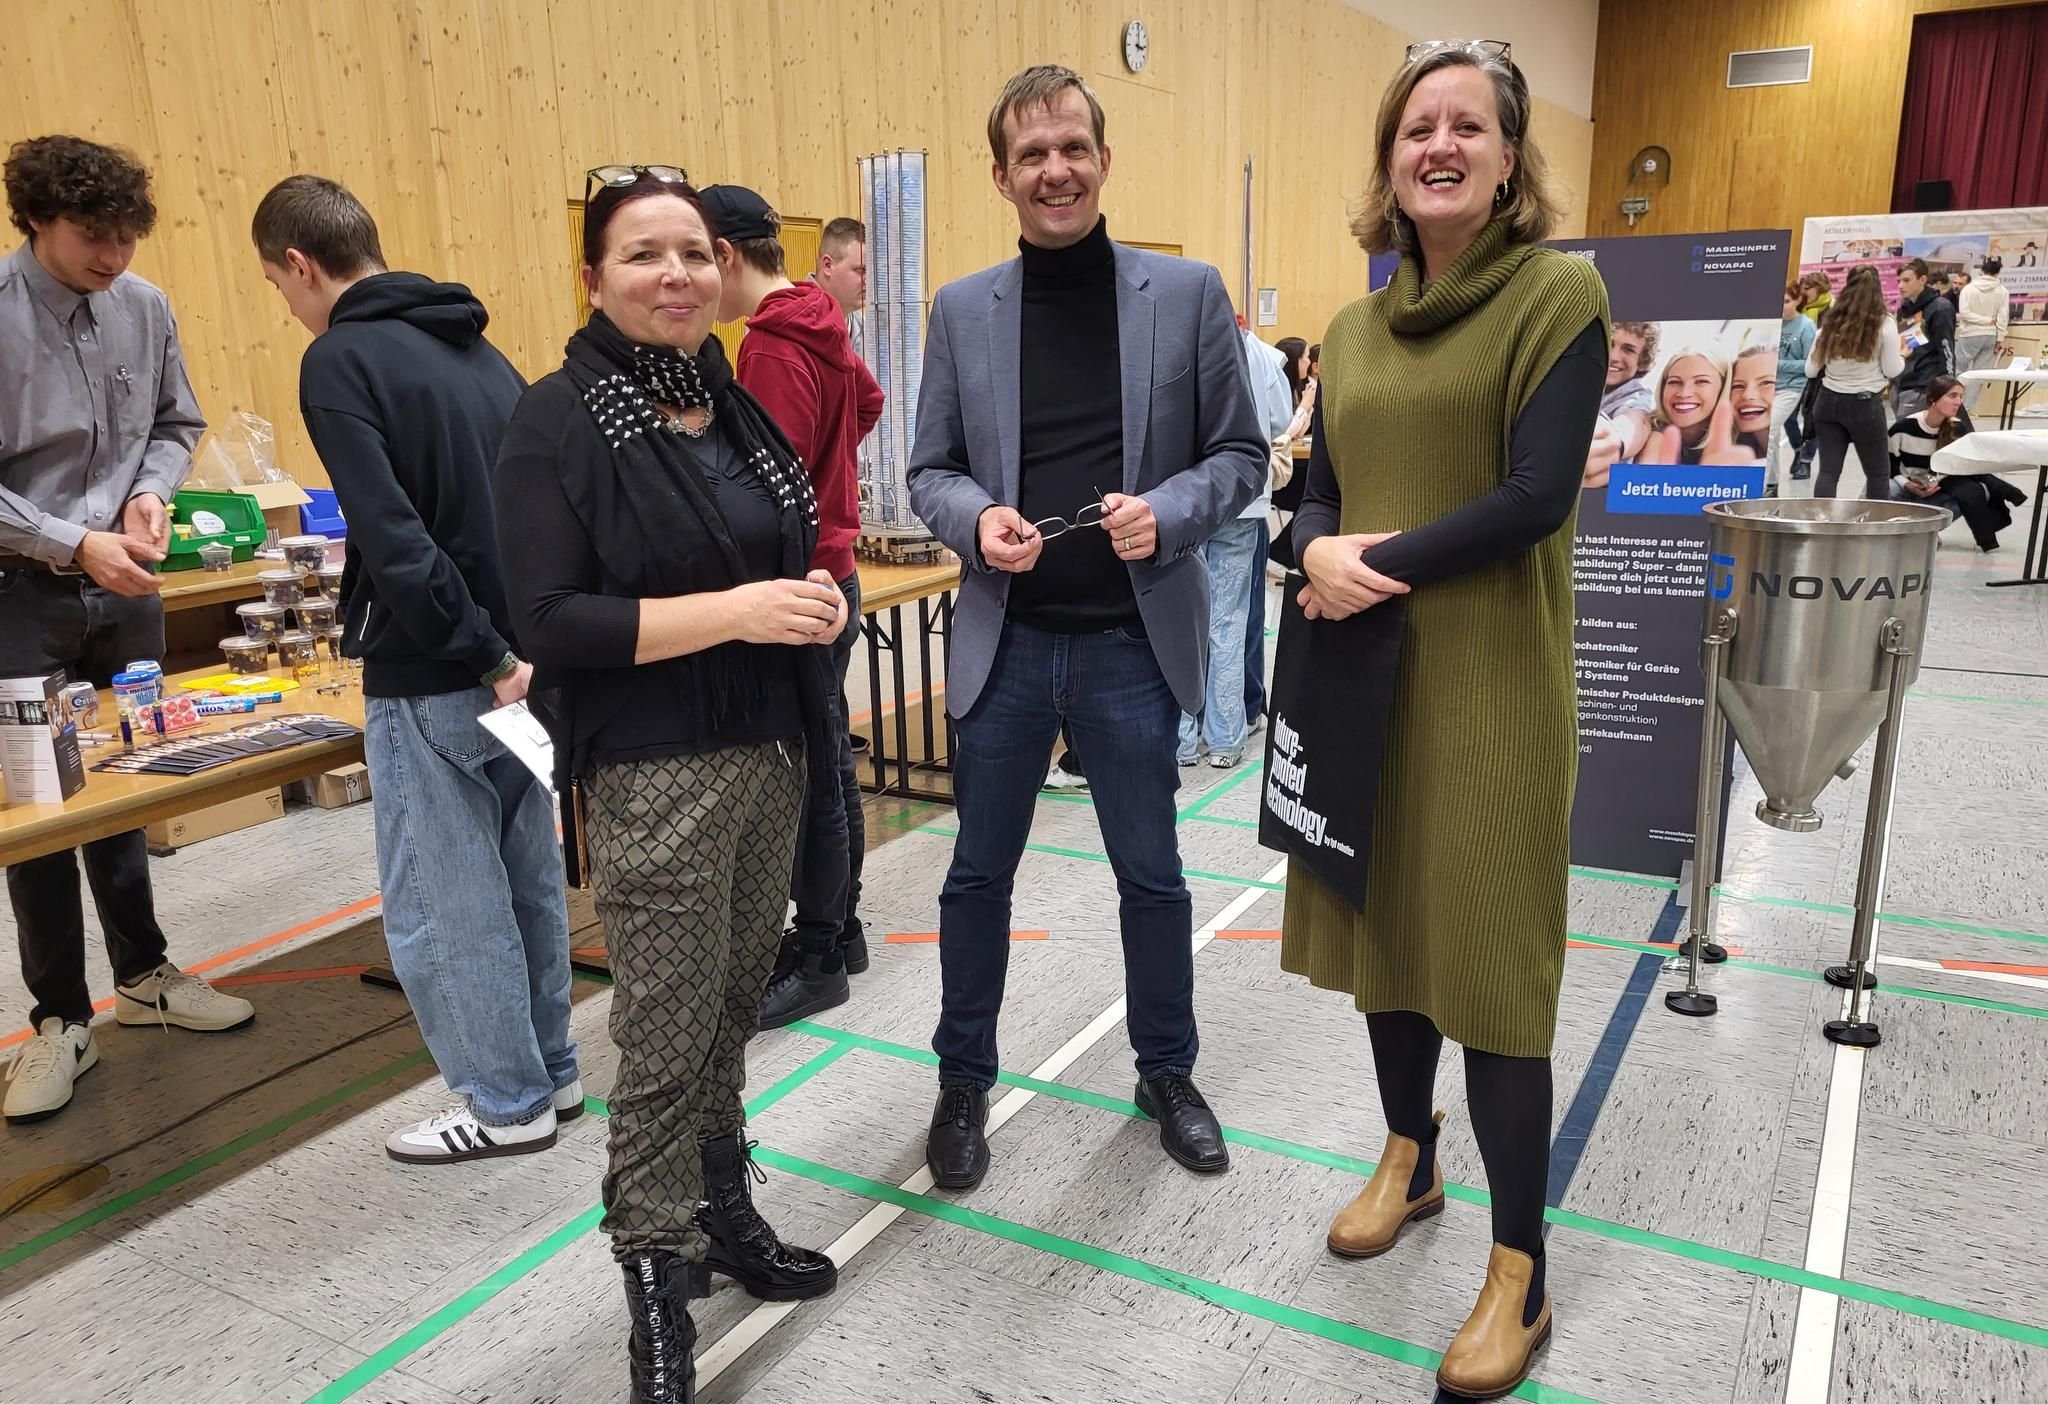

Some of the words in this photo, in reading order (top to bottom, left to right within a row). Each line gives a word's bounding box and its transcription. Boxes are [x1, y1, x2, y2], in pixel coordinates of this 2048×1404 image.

[1705, 244, 1777, 254] MASCHINPEX
[1703, 262, 1754, 270] NOVAPAC
[1621, 481, 1660, 497] Jetzt
[1662, 482, 1748, 498] bewerben!
[1585, 534, 1608, 545] hast
[1610, 535, 1658, 546] Interesse
[1660, 538, 1674, 547] an
[1676, 538, 1705, 548] einer
[1631, 549, 1656, 559] oder
[1574, 558, 1630, 571] usbildung?
[1632, 560, 1665, 572] Super
[1675, 562, 1703, 573] dann
[1573, 569, 1618, 581] formiere
[1620, 572, 1642, 582] dich
[1643, 573, 1669, 584] jetzt
[1671, 575, 1693, 585] und
[1695, 575, 1706, 585] le
[1573, 582, 1622, 595] usbildung
[1624, 584, 1641, 594] bei
[1643, 586, 1663, 595] uns
[1665, 586, 1705, 598] kennen
[1581, 618, 1614, 628] bilden
[1615, 621, 1639, 630] aus:
[1573, 641, 1639, 654] echatroniker
[1574, 658, 1625, 670] ektroniker
[1626, 661, 1643, 671] für
[1644, 662, 1681, 674] Geräte
[1584, 670, 1630, 682] Systeme
[1576, 687, 1621, 699] hnischer
[1622, 690, 1705, 706] Produktdesigne
[197, 704, 225, 714] ntos
[1577, 699, 1618, 710] schinen-
[1619, 703, 1638, 711] und
[1576, 711, 1659, 726] genkonstruktion)
[1577, 728, 1653, 742] striekaufmann
[640, 1257, 654, 1283] DINI
